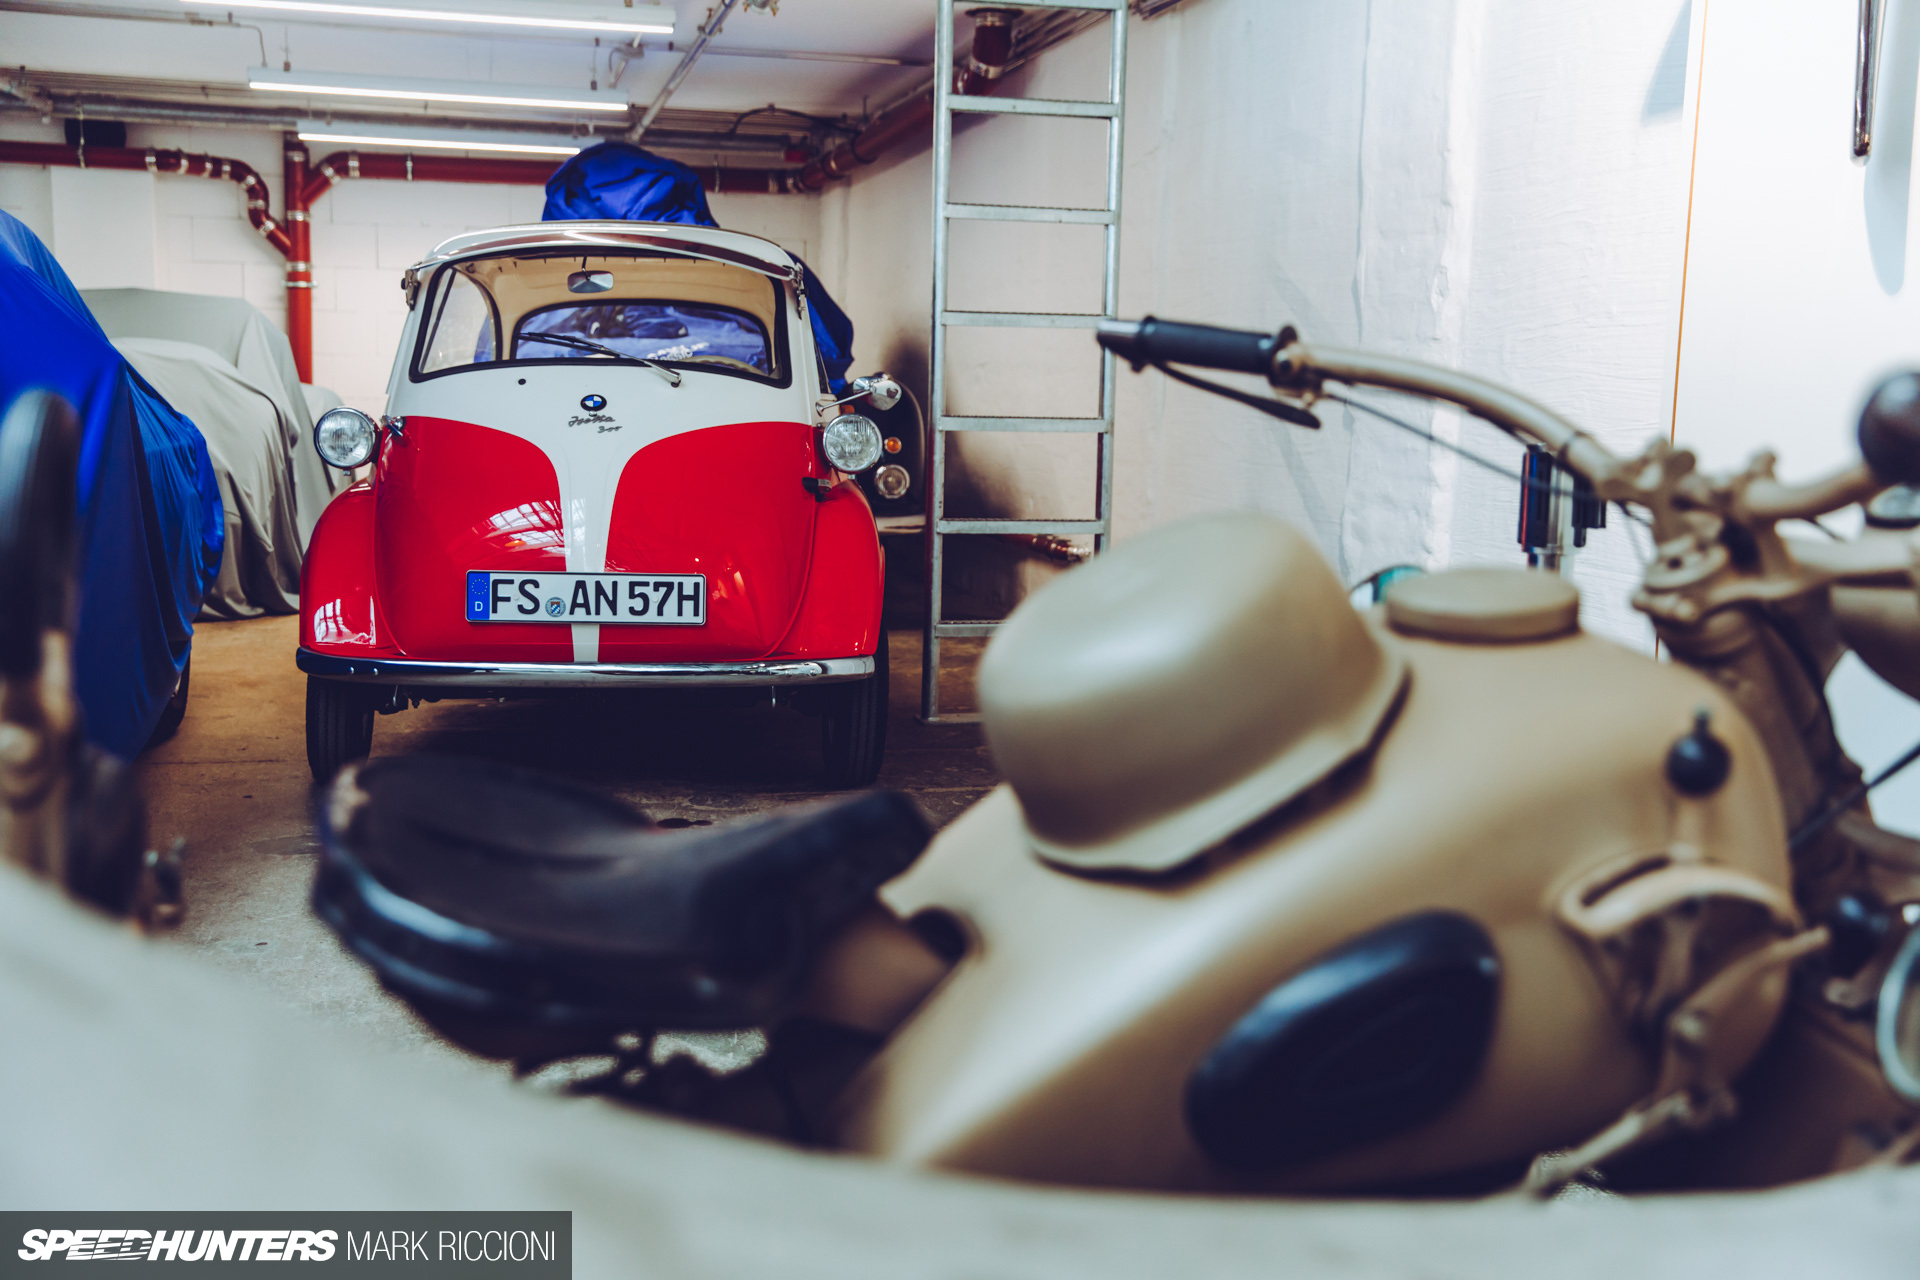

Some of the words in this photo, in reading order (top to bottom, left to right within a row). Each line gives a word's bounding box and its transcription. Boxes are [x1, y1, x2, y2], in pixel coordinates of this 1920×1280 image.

[475, 601, 483, 611] D
[491, 578, 540, 615] FS
[569, 580, 618, 616] AN
[628, 581, 701, 617] 57H
